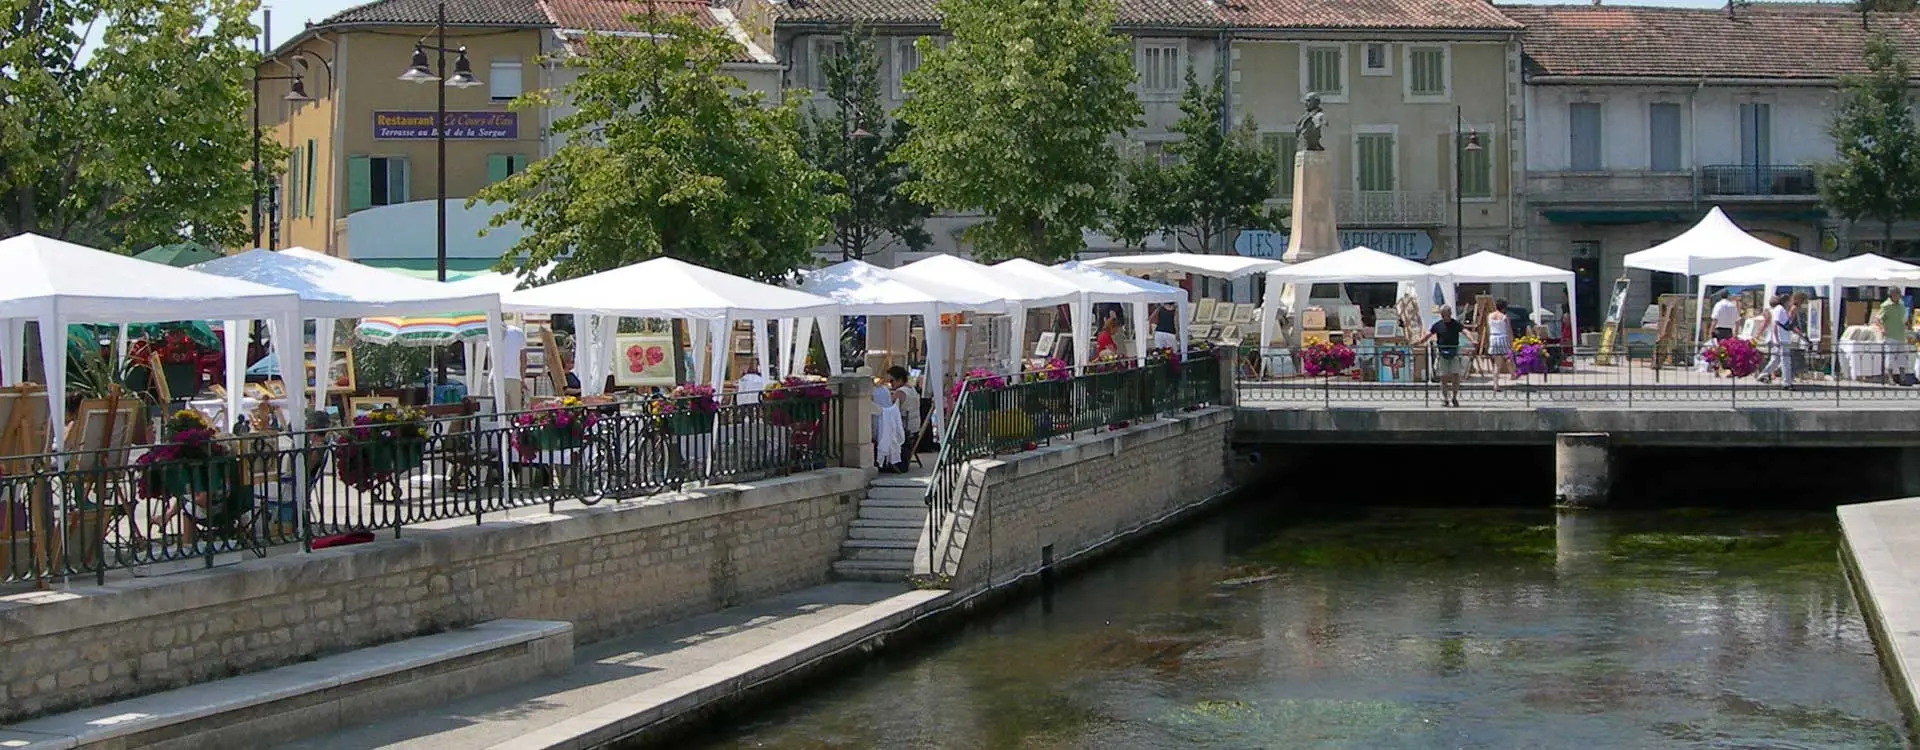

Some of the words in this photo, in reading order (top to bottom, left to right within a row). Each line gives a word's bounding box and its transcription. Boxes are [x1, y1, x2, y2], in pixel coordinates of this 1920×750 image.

[377, 114, 434, 126] Restaurant
[381, 127, 415, 137] Terrasse
[431, 127, 451, 137] Bd
[454, 128, 464, 137] de
[467, 128, 475, 137] la
[478, 128, 507, 138] Sorgue
[1249, 233, 1274, 257] LES
